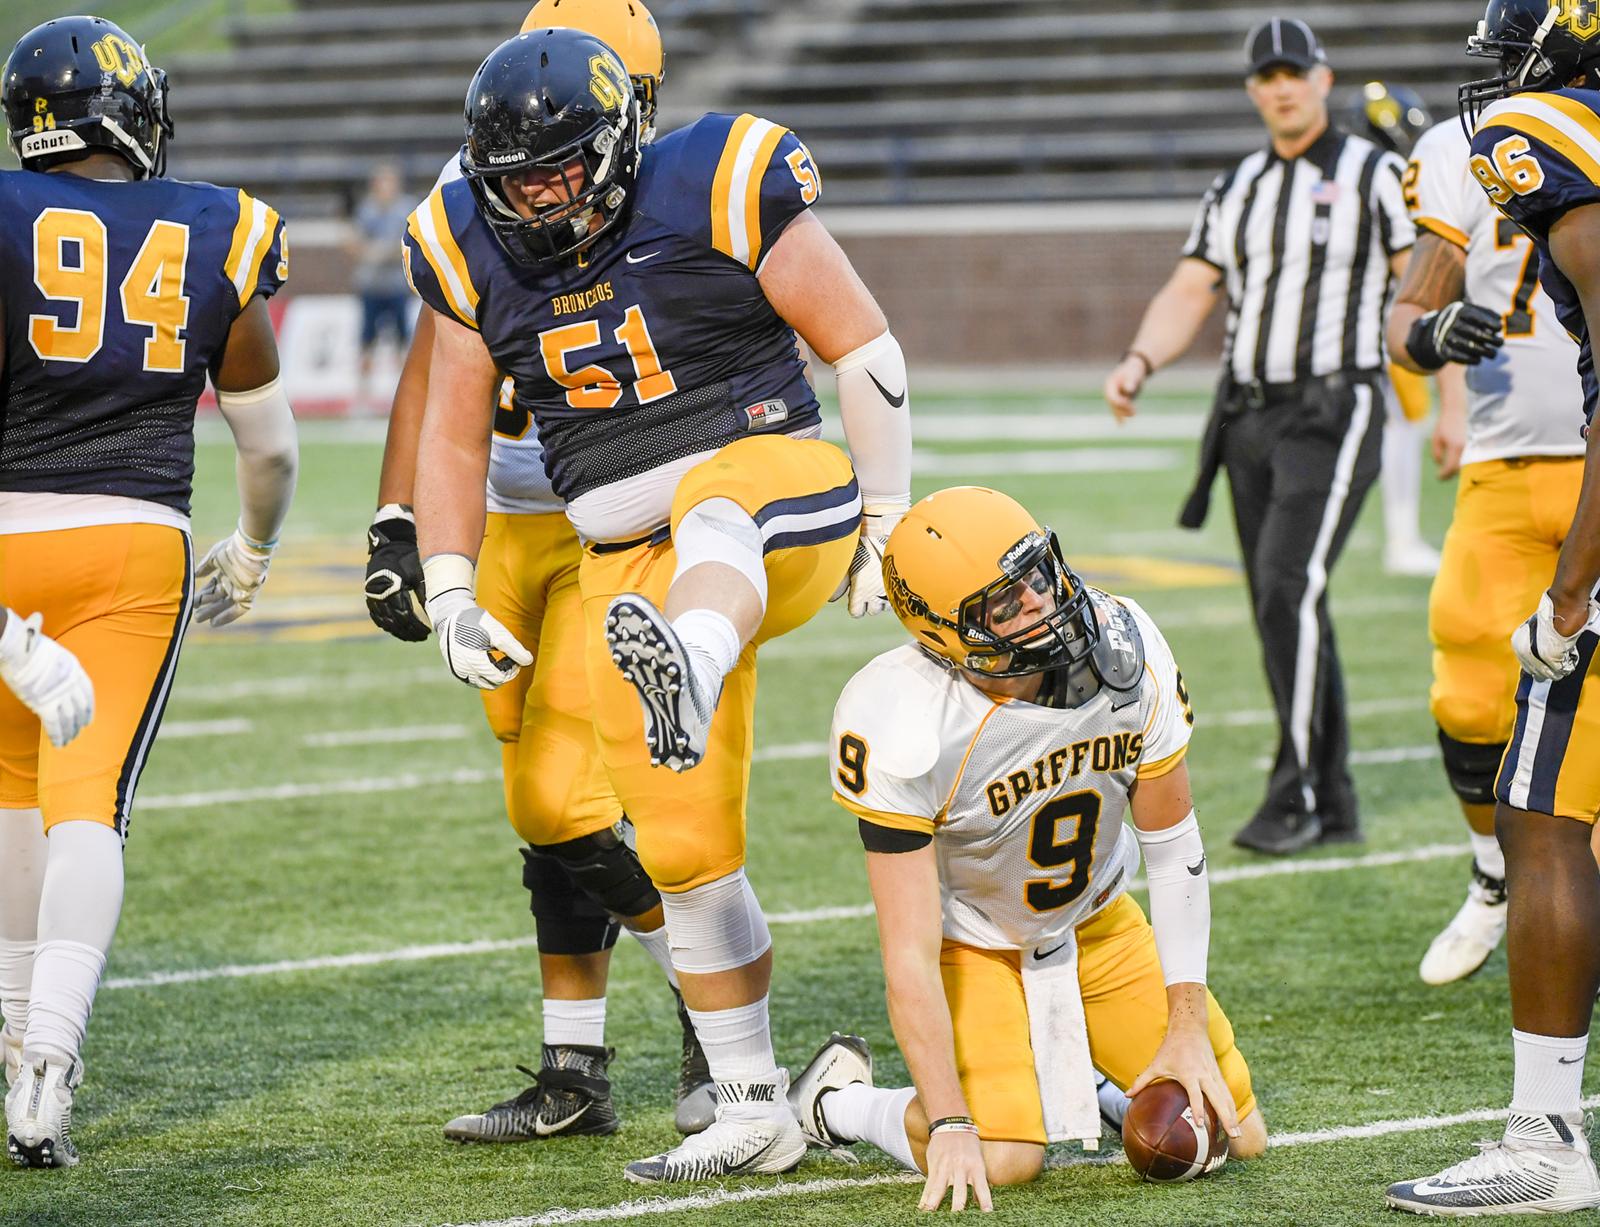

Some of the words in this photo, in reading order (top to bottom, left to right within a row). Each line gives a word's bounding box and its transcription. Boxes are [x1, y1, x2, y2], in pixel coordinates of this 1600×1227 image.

[33, 112, 56, 133] 94
[488, 151, 526, 164] Riddell
[1469, 134, 1546, 205] 96
[28, 207, 190, 373] 94
[537, 304, 679, 408] 51
[767, 403, 779, 413] XL
[837, 730, 870, 797] 9
[986, 732, 1143, 817] GRIFFONS
[1023, 788, 1103, 914] 9
[745, 1084, 776, 1102] NIKE
